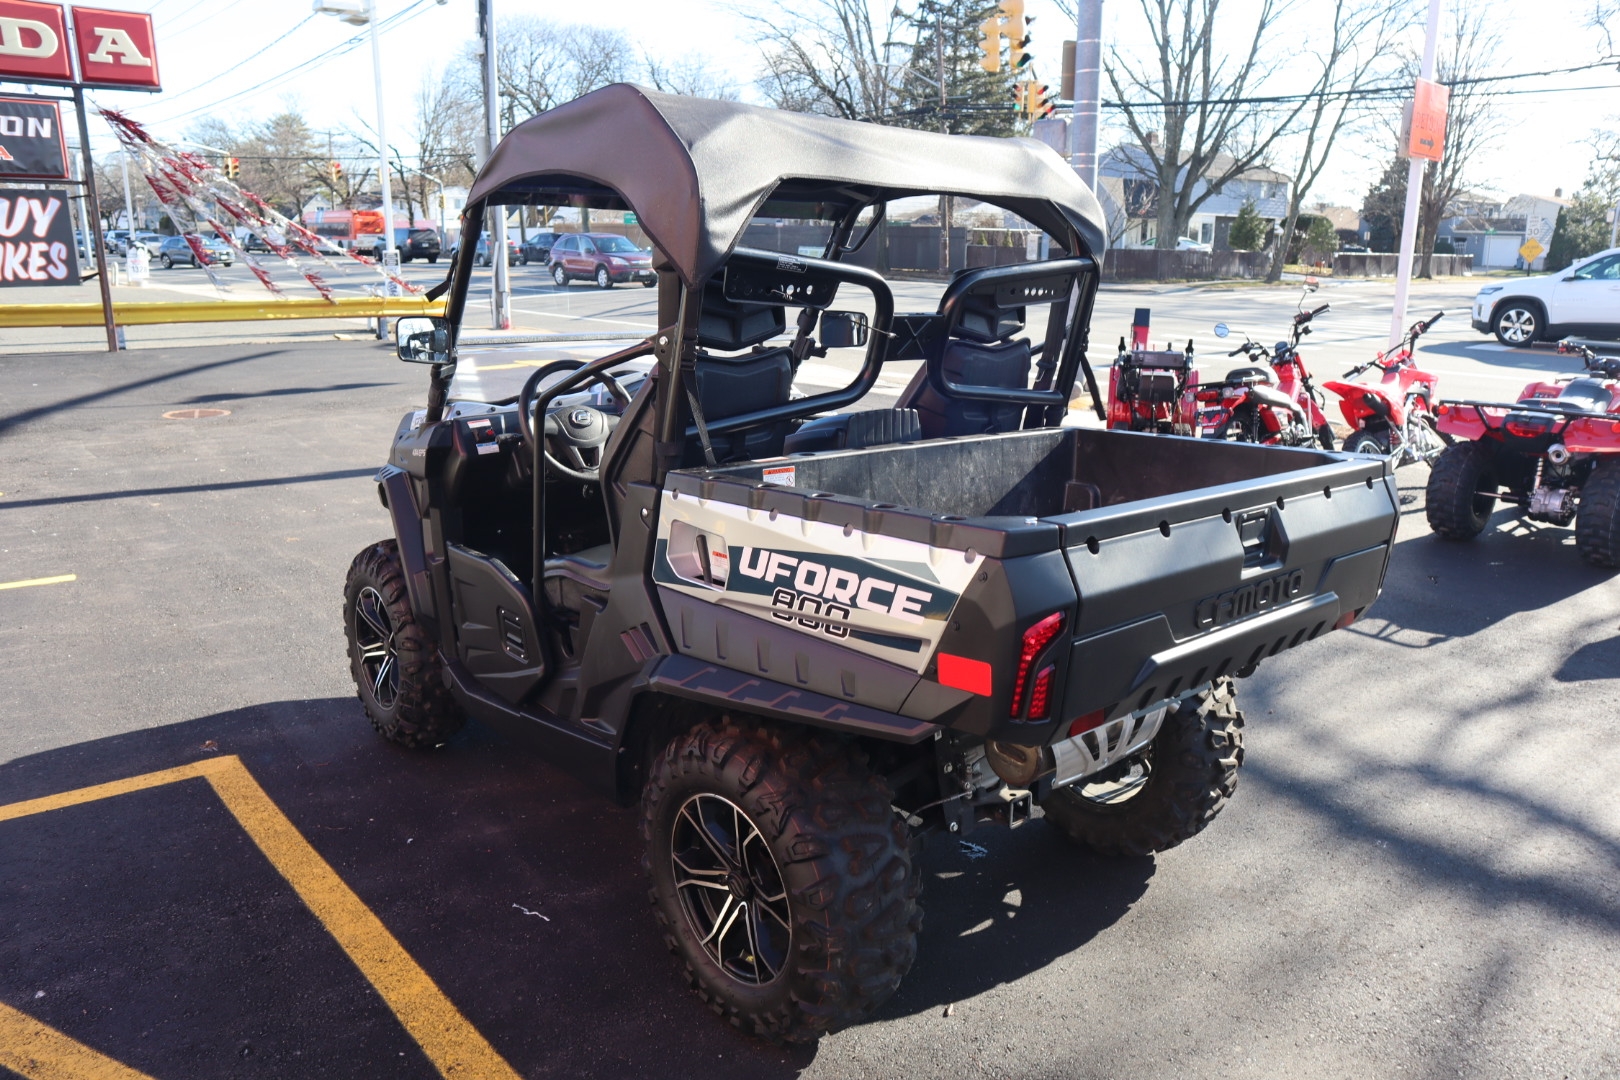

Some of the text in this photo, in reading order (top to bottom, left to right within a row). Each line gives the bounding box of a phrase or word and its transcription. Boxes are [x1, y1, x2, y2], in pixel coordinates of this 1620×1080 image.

[0, 115, 52, 138] ON
[1528, 228, 1540, 236] 30
[739, 546, 933, 625] UFORCE
[1195, 568, 1305, 630] CFMOTO
[771, 586, 851, 641] 800
